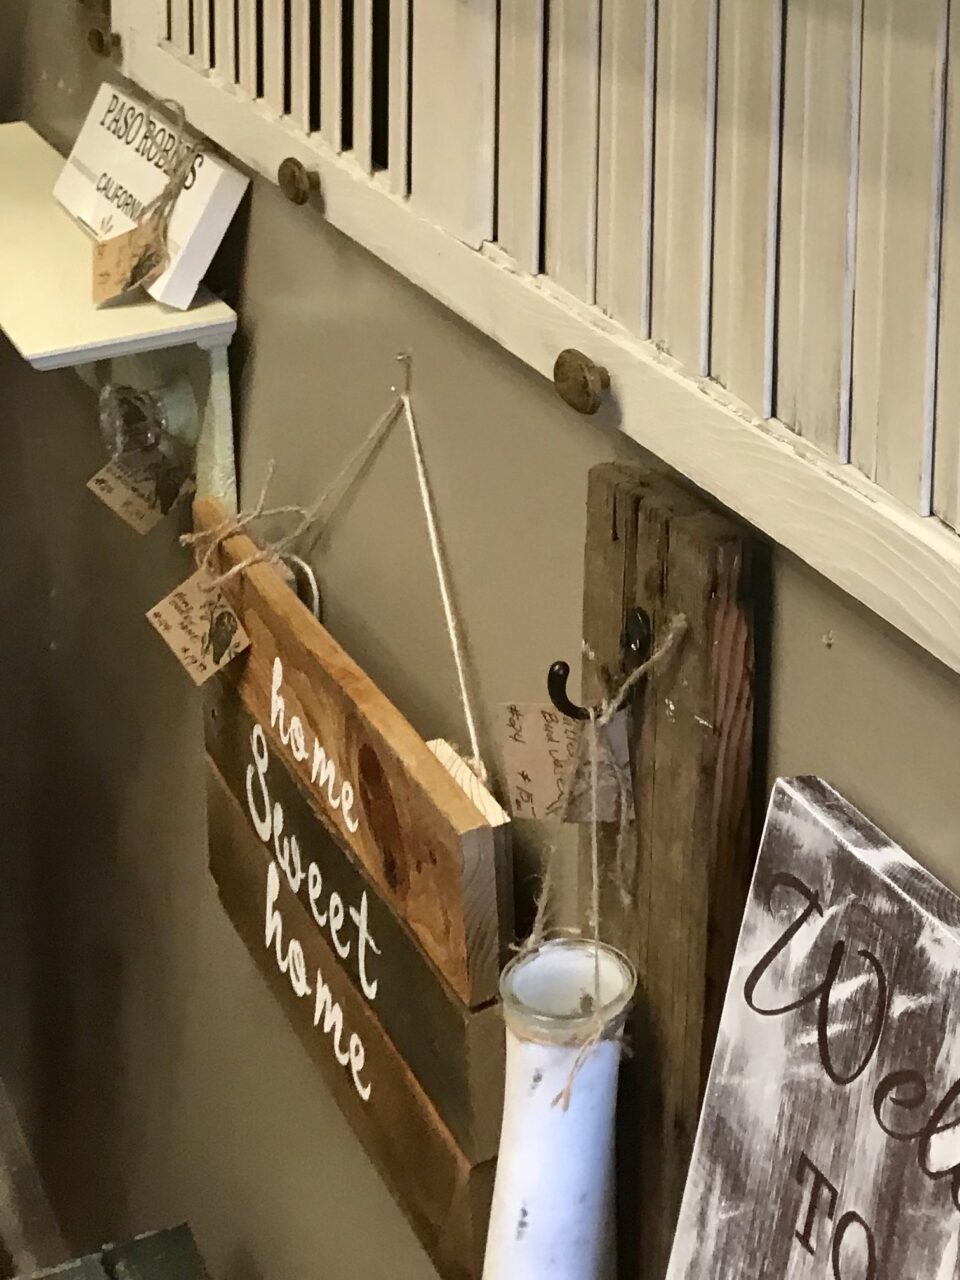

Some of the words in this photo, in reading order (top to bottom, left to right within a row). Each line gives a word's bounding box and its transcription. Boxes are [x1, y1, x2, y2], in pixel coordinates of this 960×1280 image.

[100, 94, 144, 145] PASO
[134, 119, 204, 190] ROBS
[271, 656, 359, 833] home
[246, 723, 381, 1000] Sweet
[264, 861, 371, 1101] home
